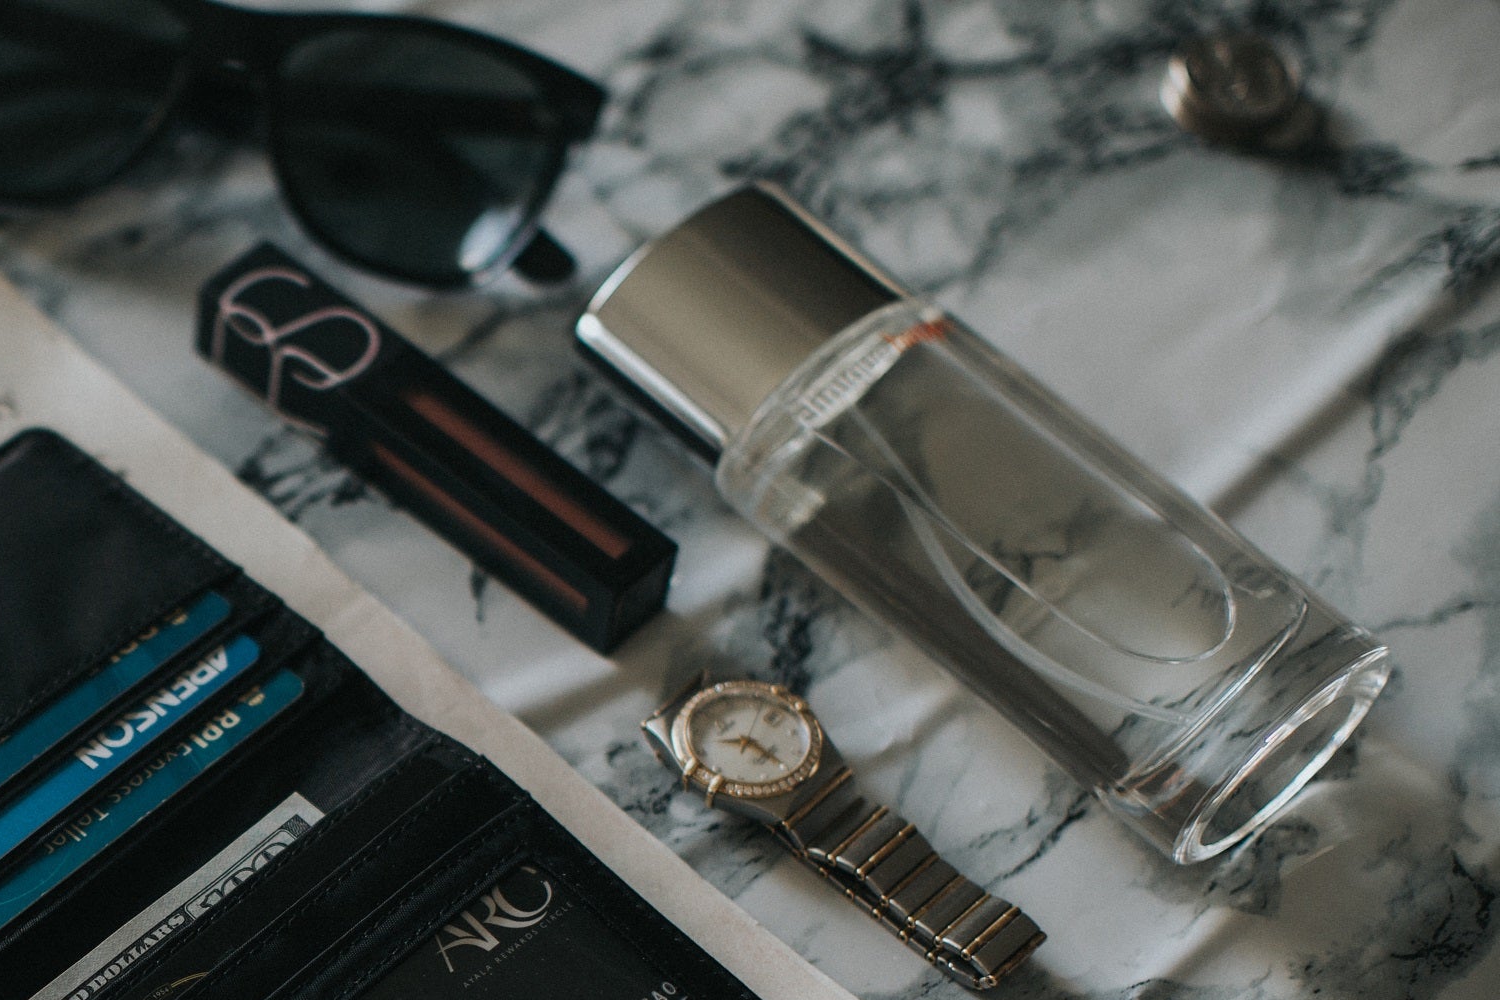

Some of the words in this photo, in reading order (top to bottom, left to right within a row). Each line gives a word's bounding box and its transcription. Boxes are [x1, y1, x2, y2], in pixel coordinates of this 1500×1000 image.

[86, 913, 186, 993] DOLLARS
[435, 866, 554, 973] ARC
[463, 964, 491, 988] AYALA
[495, 928, 538, 964] REWARDS
[537, 900, 572, 929] CIRCLE
